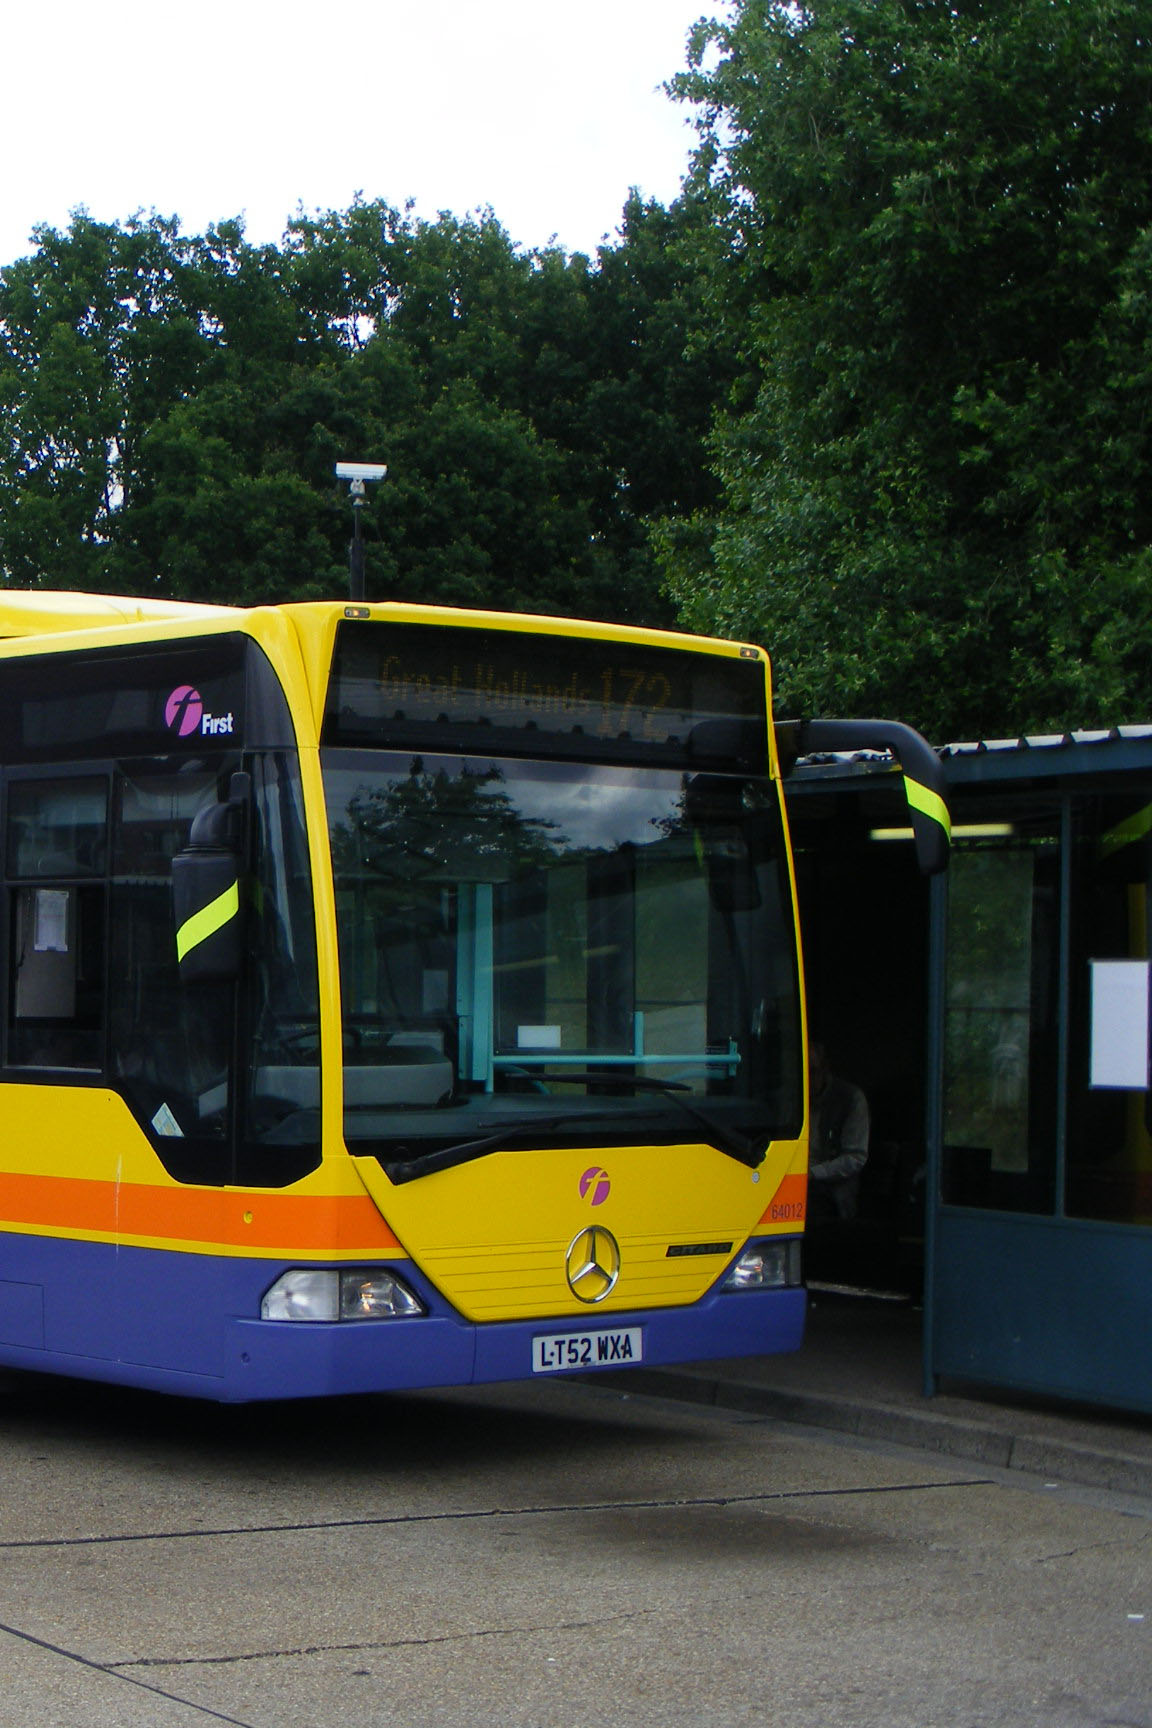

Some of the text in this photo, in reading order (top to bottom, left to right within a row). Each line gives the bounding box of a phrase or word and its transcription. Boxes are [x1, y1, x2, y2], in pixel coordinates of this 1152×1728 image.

[383, 655, 462, 705] Great
[599, 668, 671, 737] 172
[202, 712, 234, 735] First
[771, 1203, 803, 1219] 64012
[541, 1334, 632, 1366] LT52 WXA
